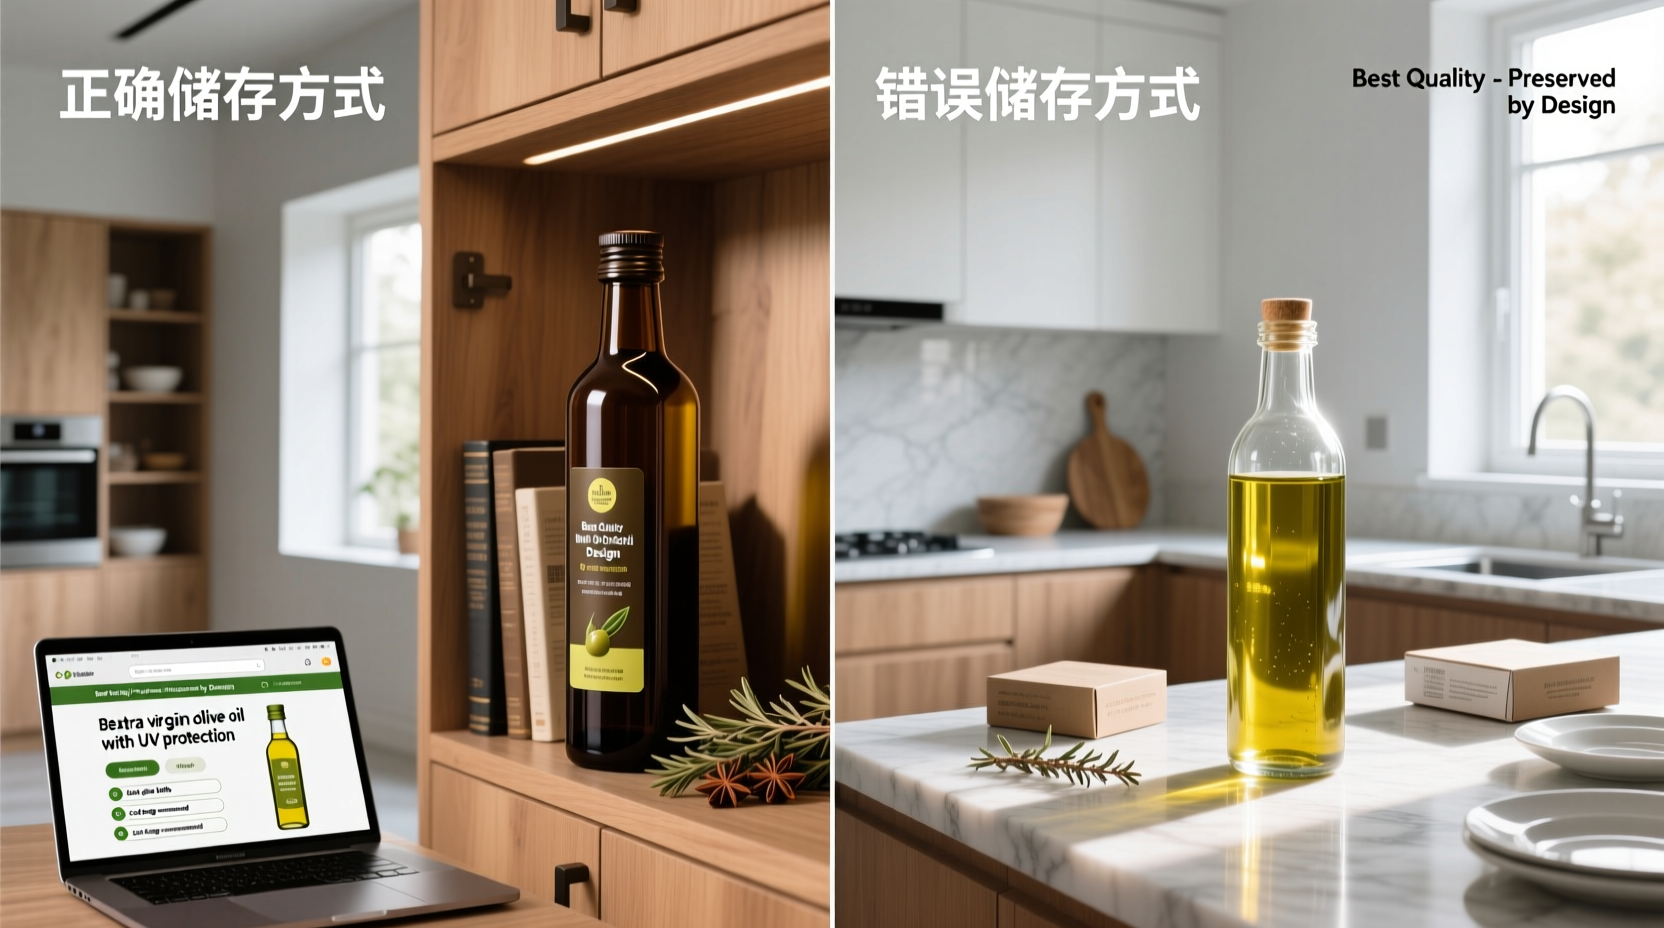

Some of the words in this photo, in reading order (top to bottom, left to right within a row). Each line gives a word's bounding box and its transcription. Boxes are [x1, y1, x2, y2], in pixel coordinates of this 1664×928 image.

[147, 712, 190, 731] virgin
[193, 709, 226, 725] olive
[228, 707, 245, 722] oil
[101, 735, 135, 751] with
[138, 732, 160, 748] UV
[162, 728, 236, 750] protection
